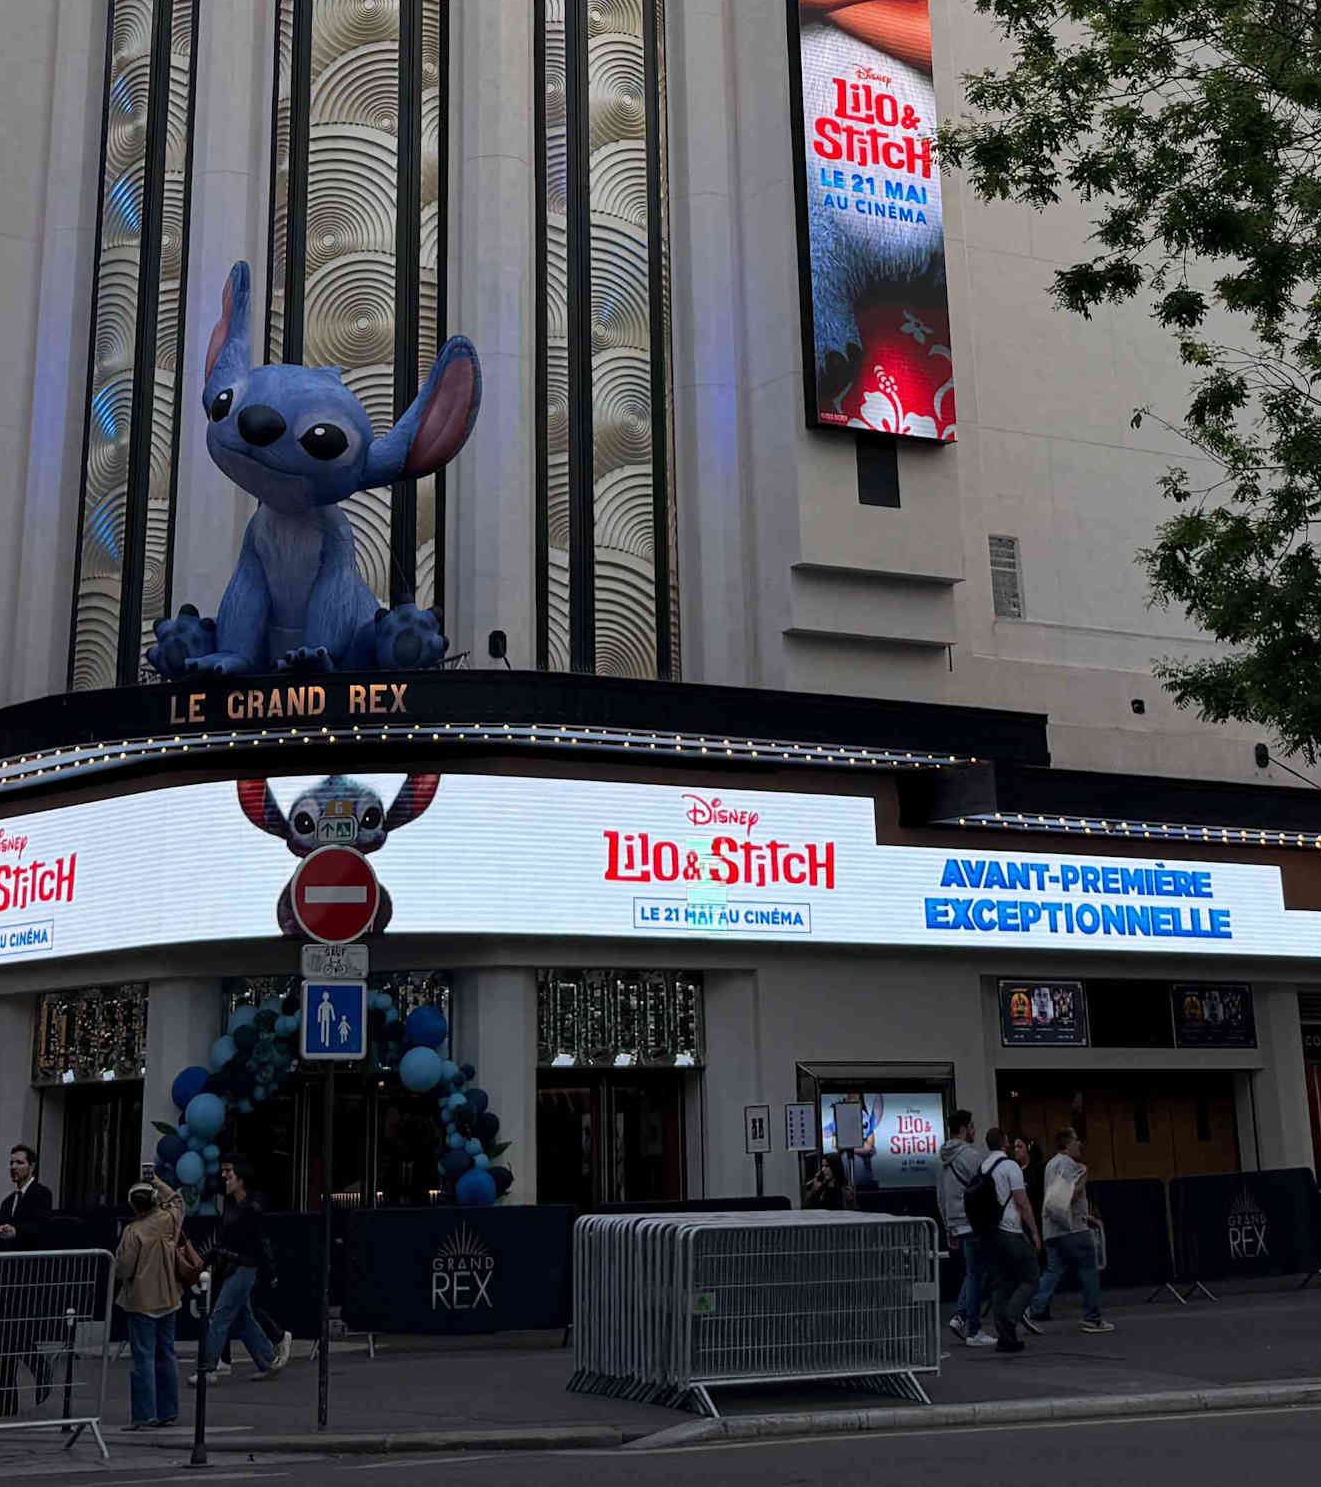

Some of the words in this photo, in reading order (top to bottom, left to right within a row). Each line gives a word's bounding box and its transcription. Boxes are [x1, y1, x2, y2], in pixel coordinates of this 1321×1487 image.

[901, 104, 921, 130] &
[821, 167, 845, 190] LE
[851, 173, 876, 196] 21
[885, 179, 928, 205] MAI
[823, 193, 849, 210] AU
[855, 199, 927, 225] CINÉMA
[170, 693, 207, 725] LE
[227, 686, 326, 720] GRAND
[349, 683, 408, 714] REX
[681, 794, 759, 836] Disney
[682, 850, 703, 881] &
[940, 859, 1214, 898] AVANT-PREMIÈRE
[640, 907, 661, 922] LE
[664, 907, 679, 922] 21
[684, 907, 713, 925] MAI
[717, 909, 740, 925] AU
[743, 907, 805, 926] CINÉMA
[924, 897, 1233, 939] EXCEPTIONNELLE
[9, 927, 48, 948] CINÉMA
[1229, 1226, 1270, 1258] REX
[432, 1257, 494, 1271] GRAND
[432, 1270, 494, 1310] REX
